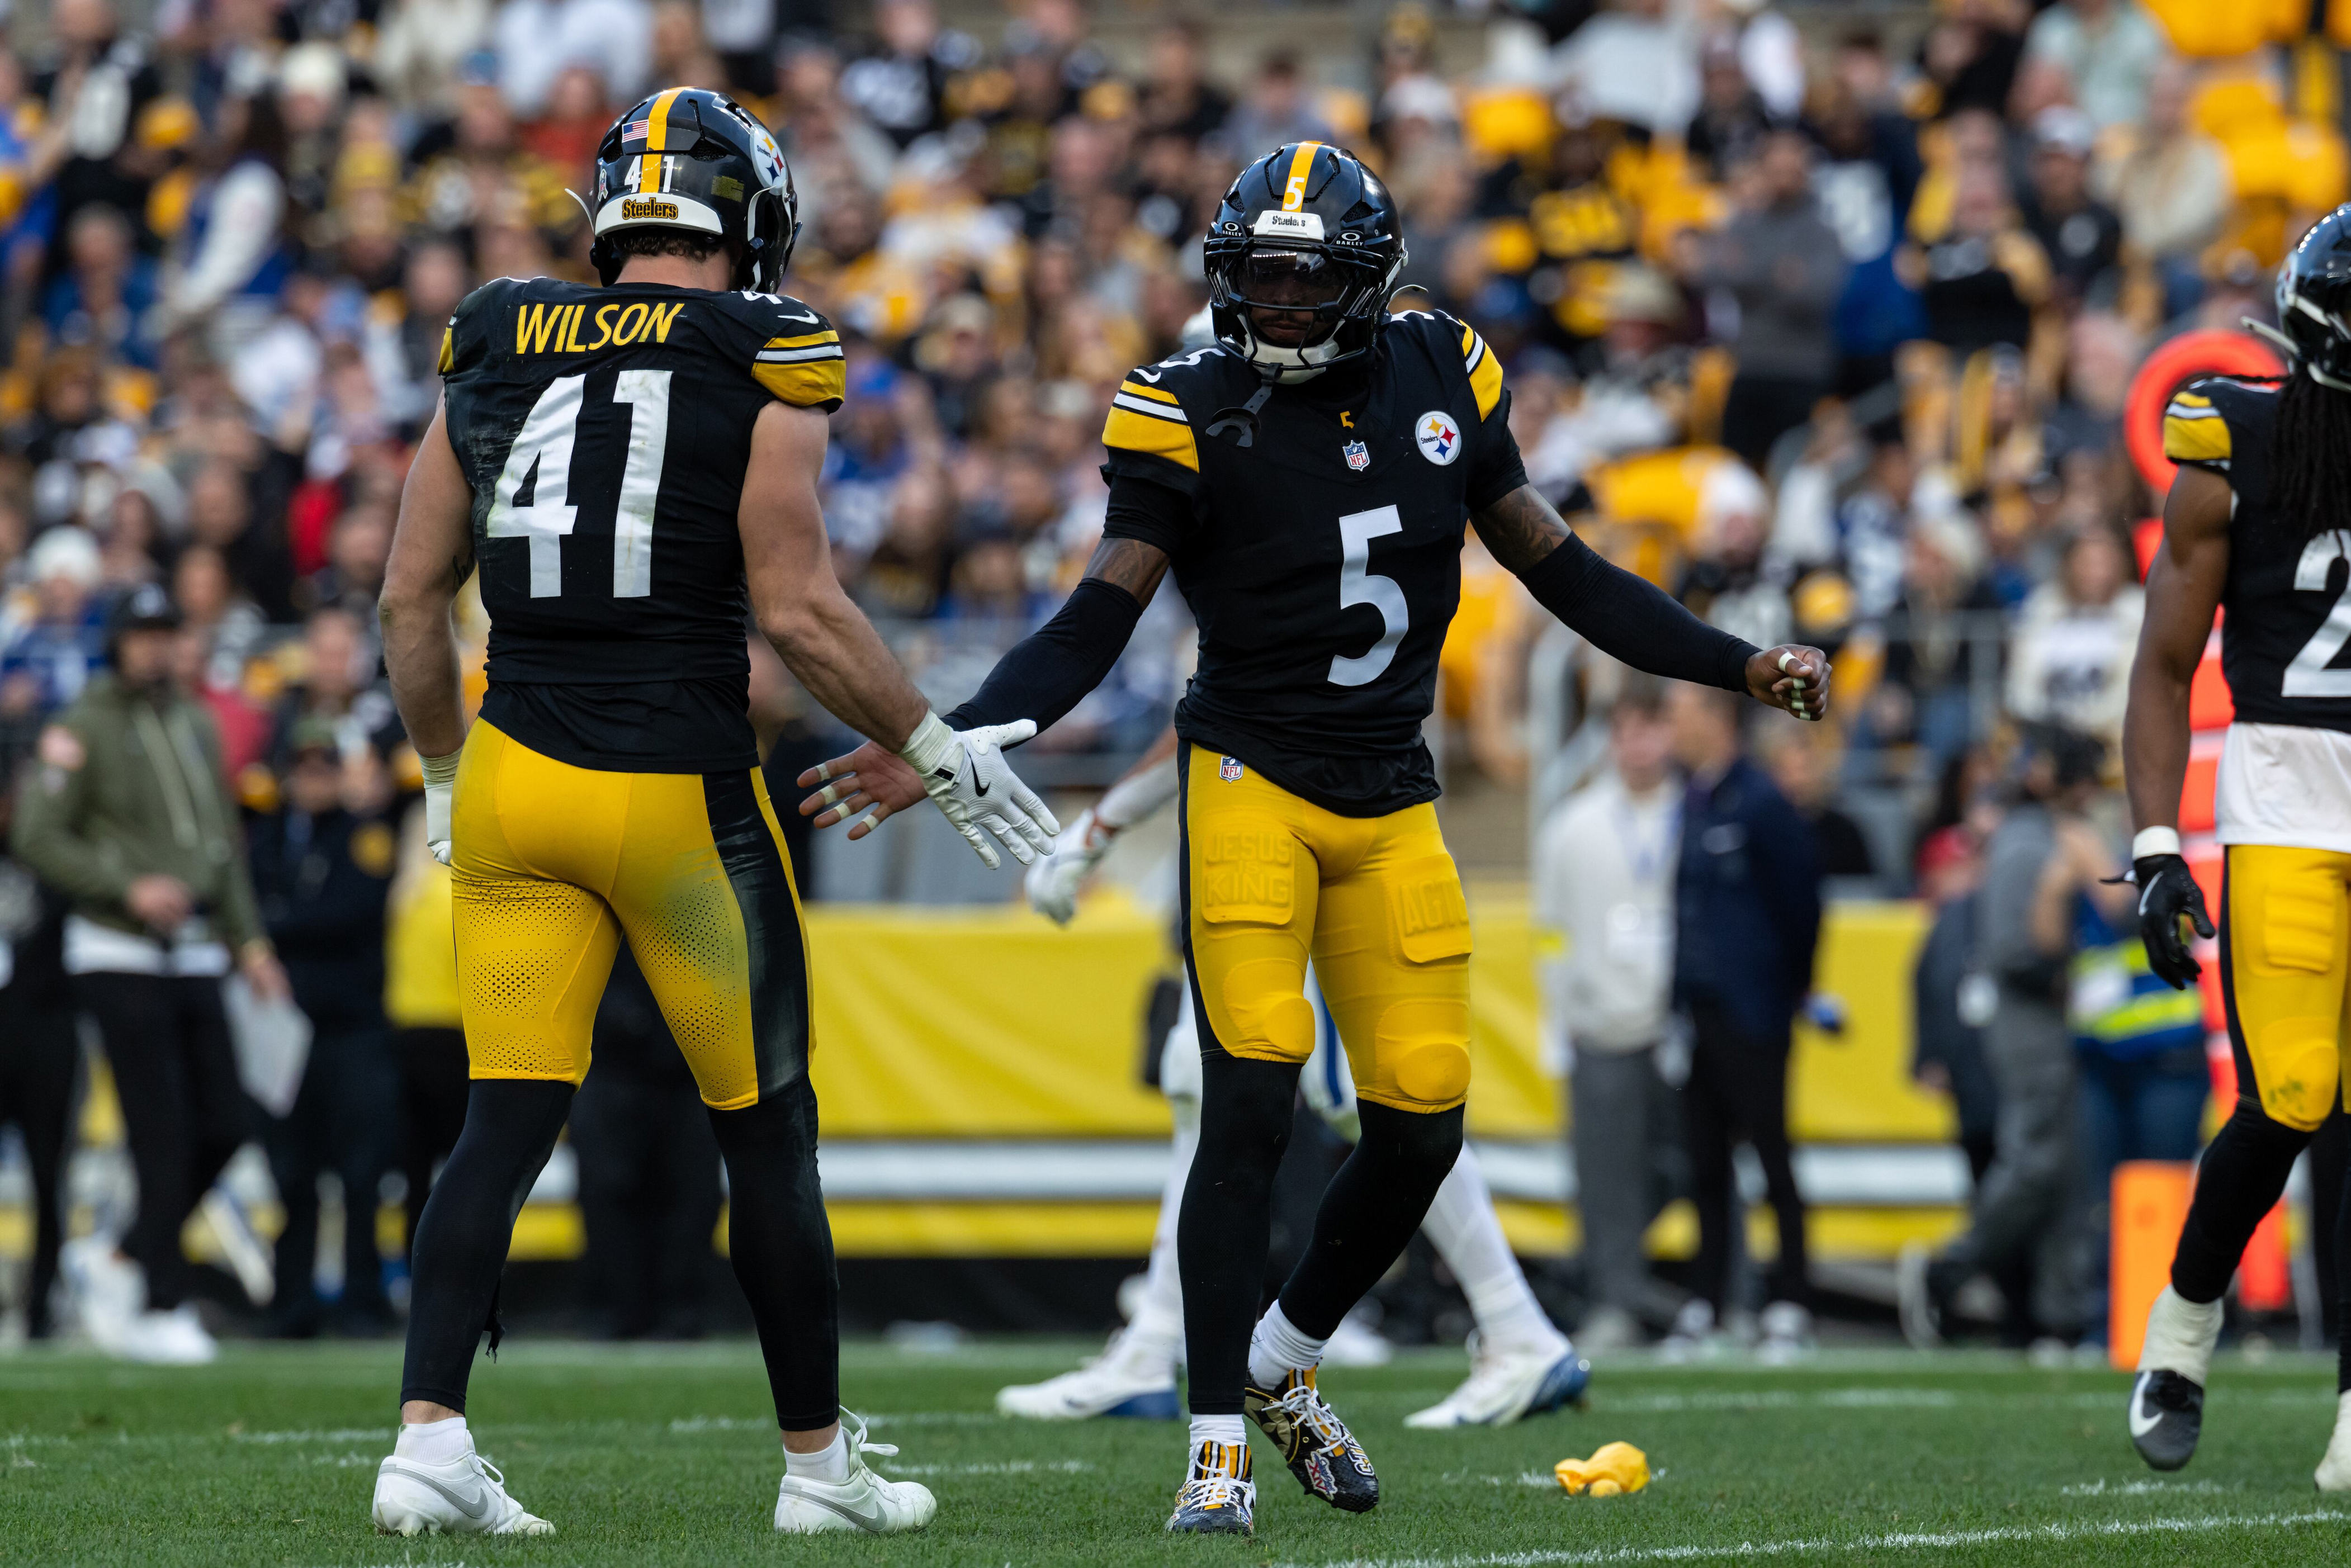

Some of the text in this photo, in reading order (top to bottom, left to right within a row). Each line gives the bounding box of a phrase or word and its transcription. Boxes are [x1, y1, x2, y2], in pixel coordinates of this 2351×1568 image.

[624, 155, 675, 193] 41
[622, 197, 678, 220] Steelers
[1284, 177, 1304, 210] 5
[515, 302, 685, 354] WILSON
[1421, 435, 1439, 444] Steelers
[1350, 453, 1366, 466] NFL
[487, 370, 674, 598] 41
[1328, 504, 1409, 686] 5
[2281, 529, 2351, 697] 2
[1223, 766, 1239, 777] NFL
[1207, 832, 1292, 863] JESUS
[1207, 873, 1290, 904] KING
